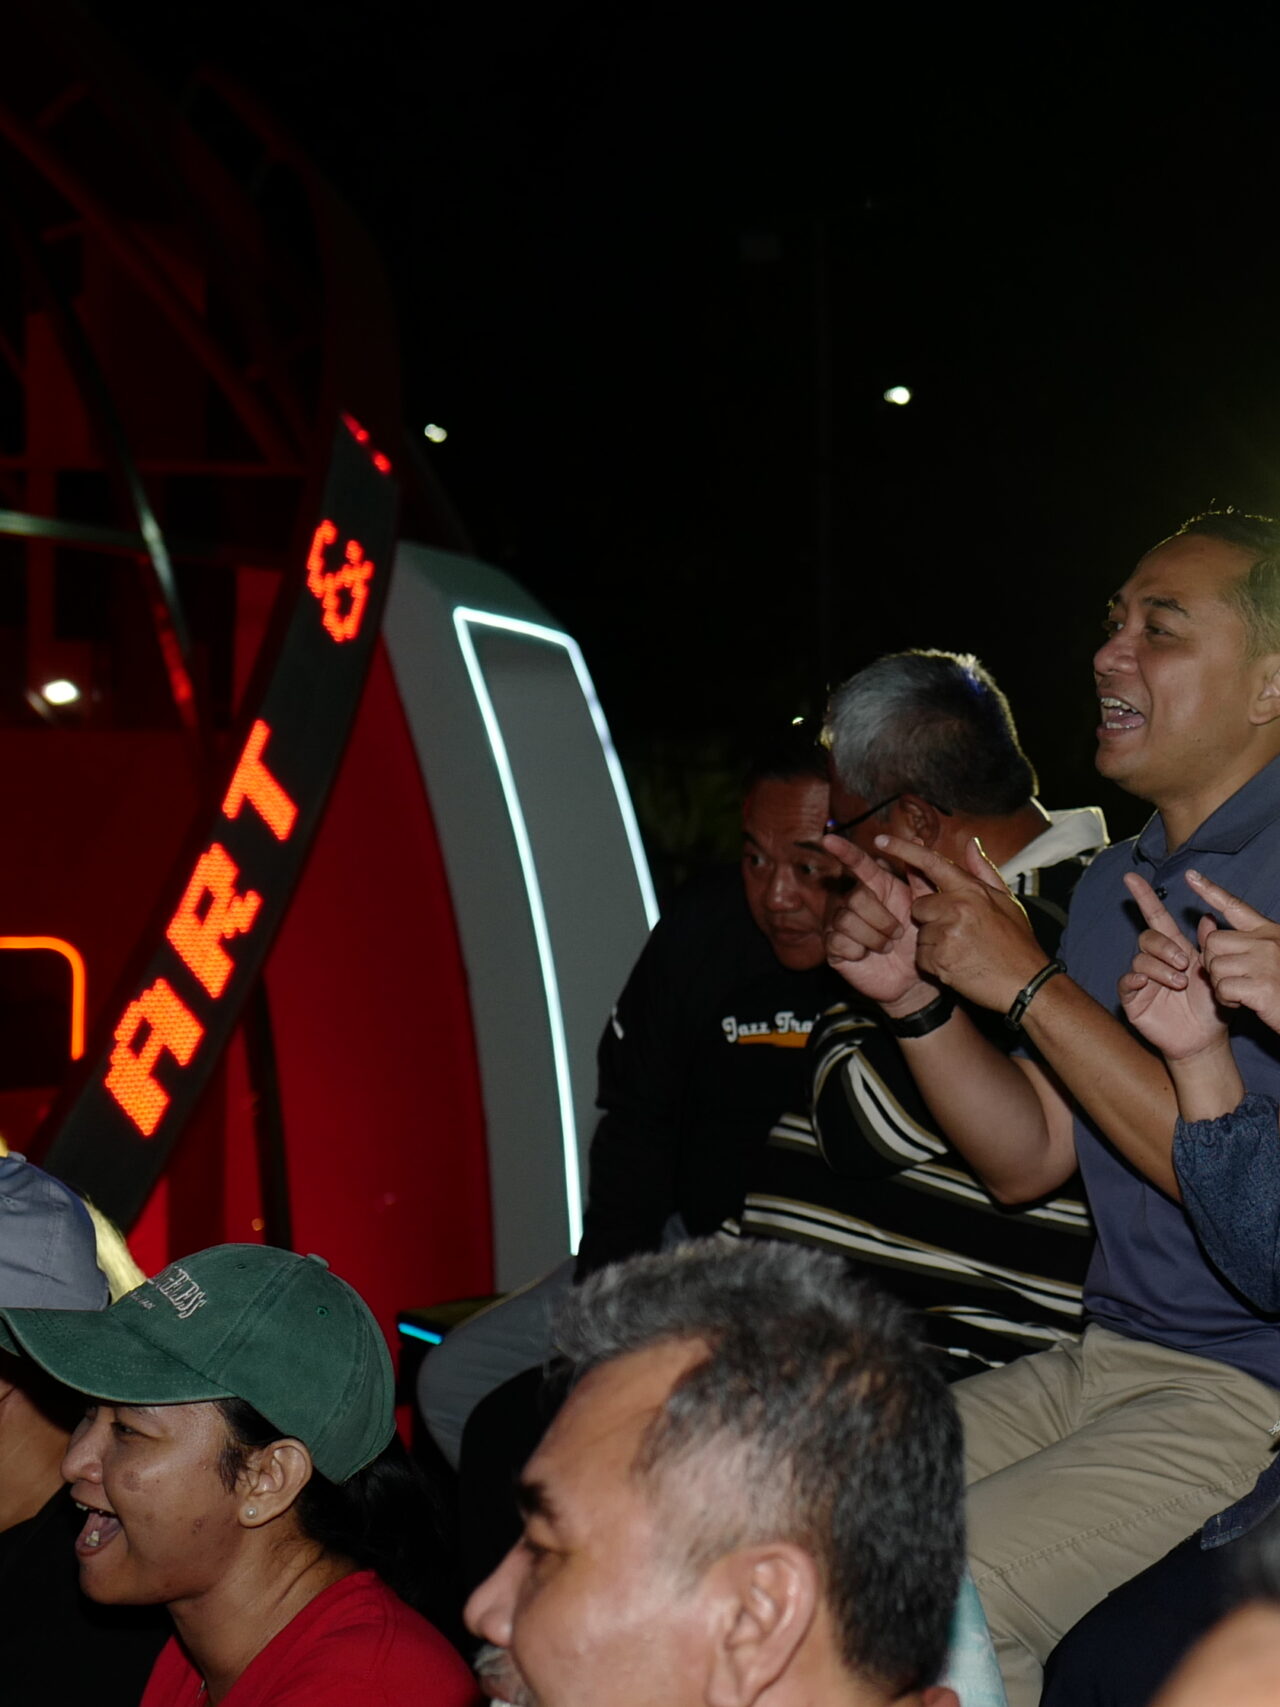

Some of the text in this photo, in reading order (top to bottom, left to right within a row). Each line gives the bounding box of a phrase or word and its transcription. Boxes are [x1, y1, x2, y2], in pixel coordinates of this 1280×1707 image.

[104, 518, 374, 1138] ART &
[721, 1010, 820, 1043] Jazz Tra
